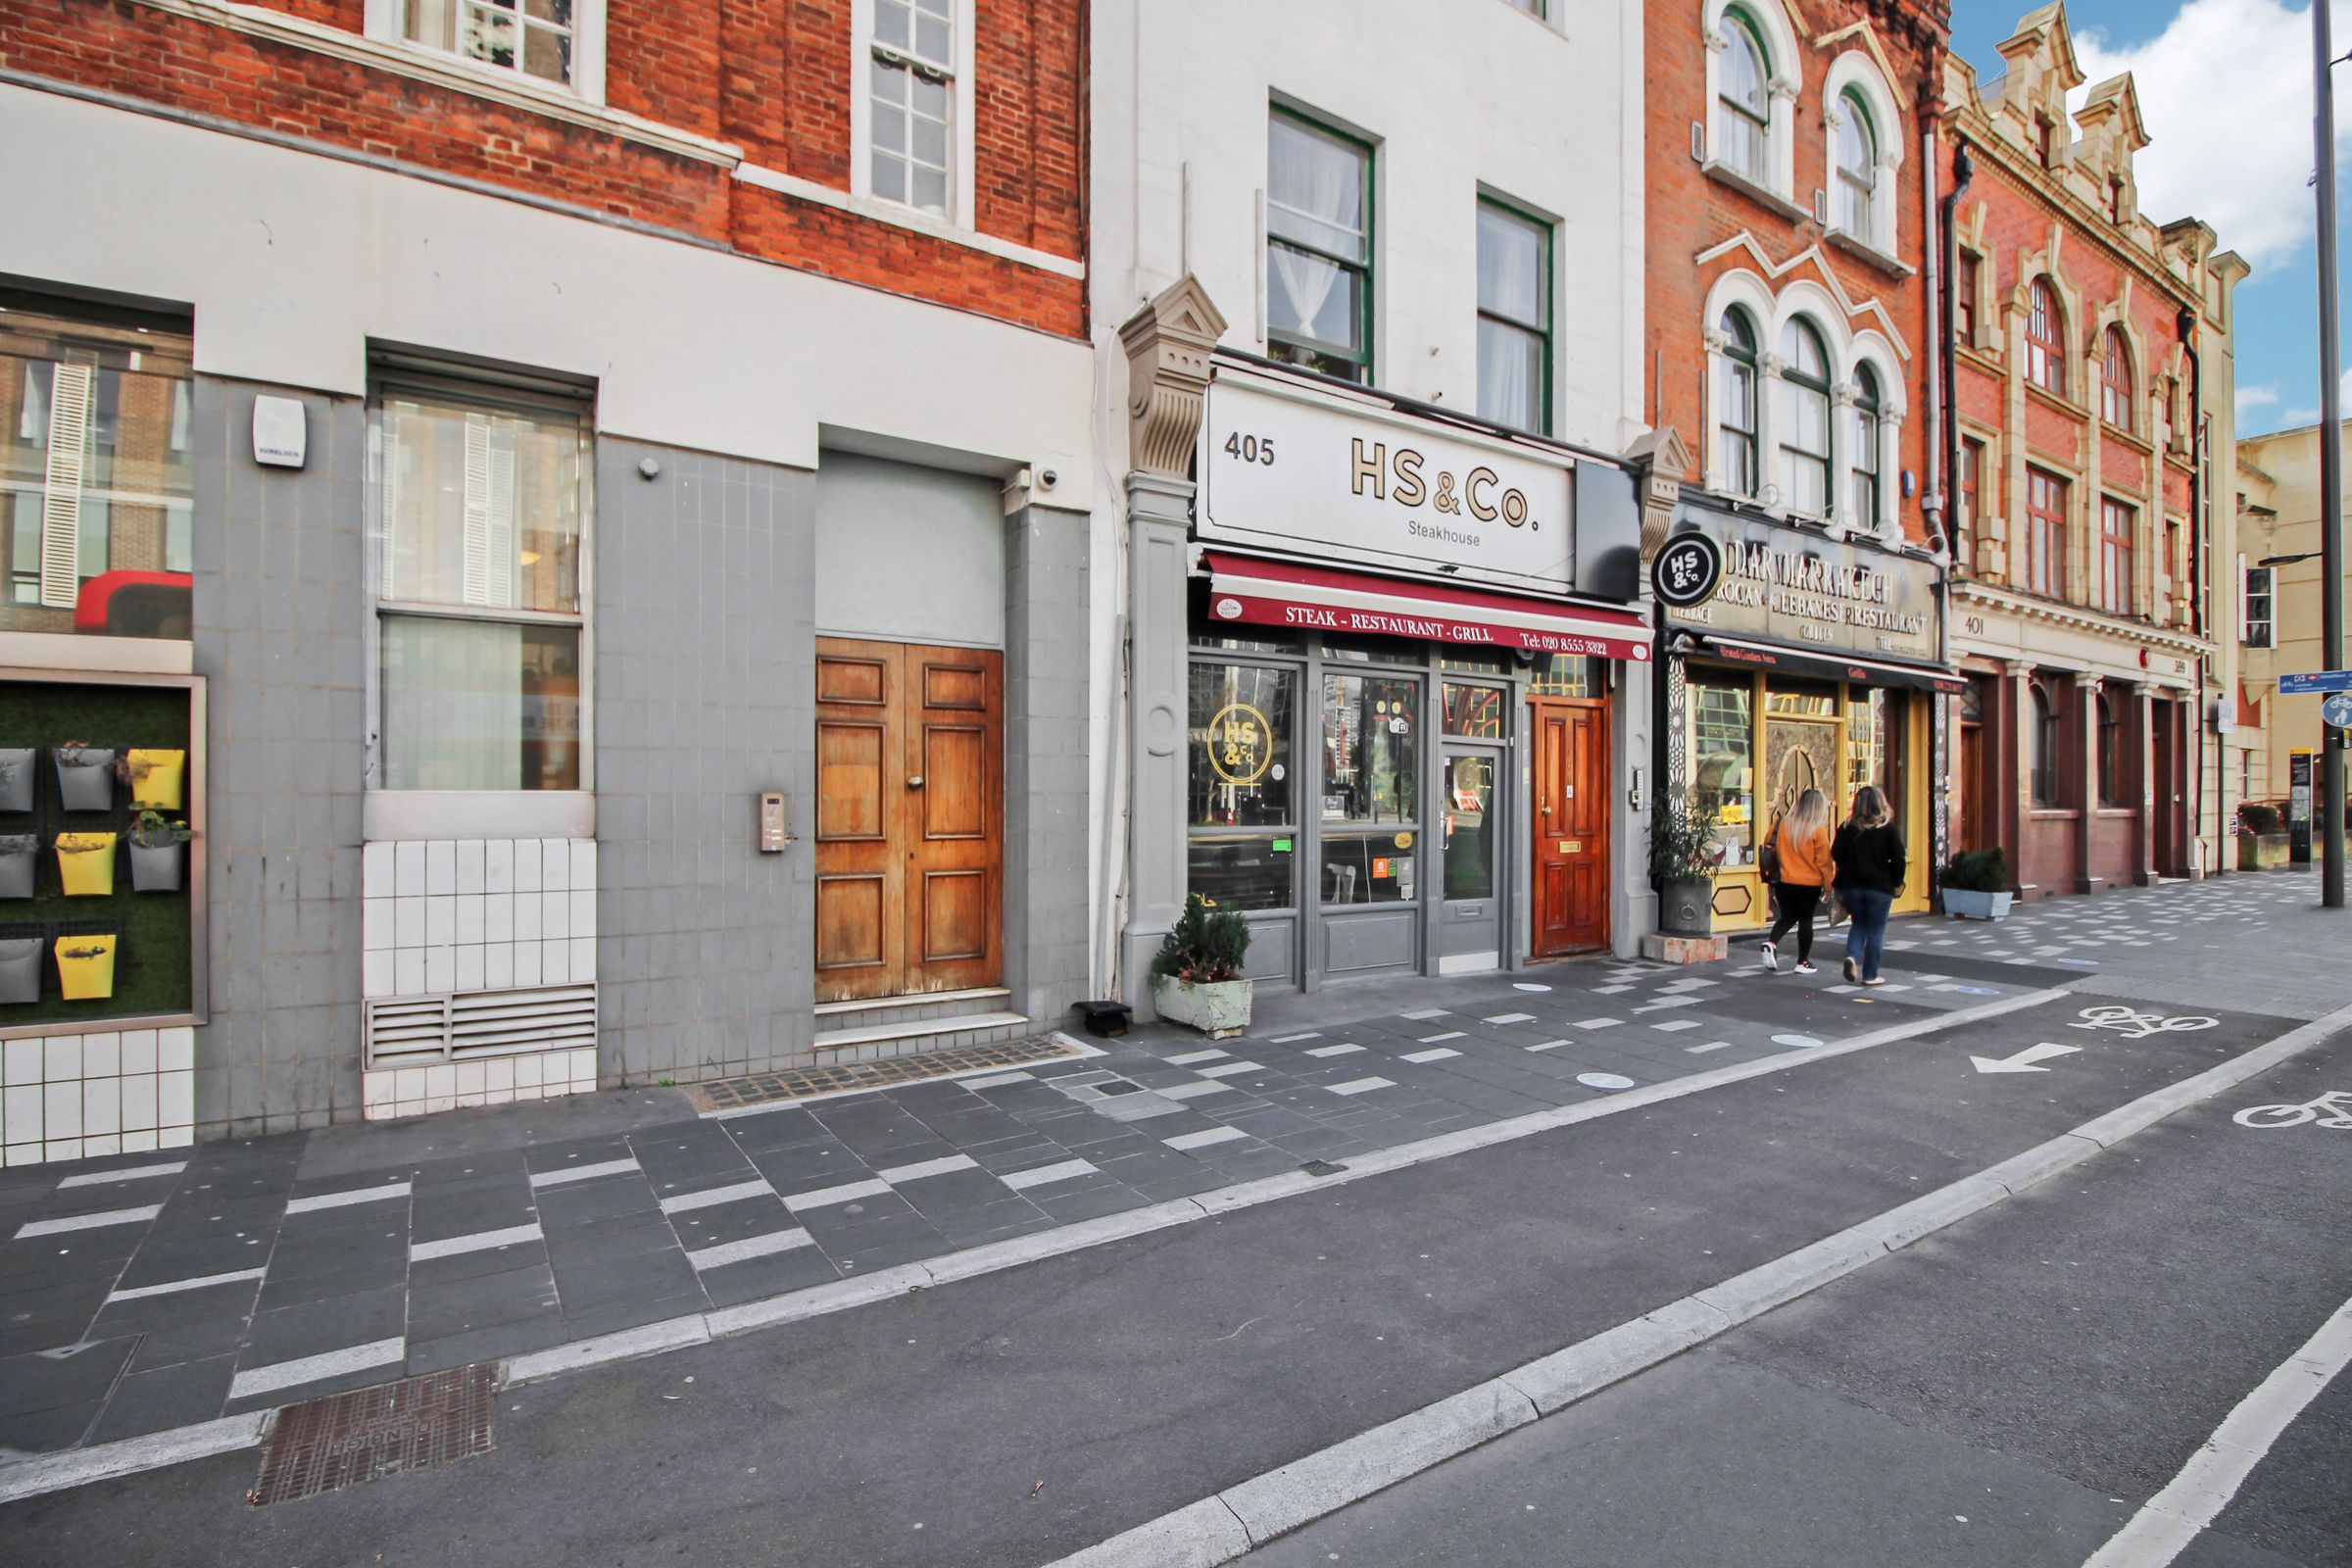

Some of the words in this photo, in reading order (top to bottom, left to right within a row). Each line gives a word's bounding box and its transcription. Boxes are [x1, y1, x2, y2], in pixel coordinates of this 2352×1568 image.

[1224, 431, 1274, 466] 405
[1408, 520, 1481, 547] Steakhouse
[1671, 551, 1698, 574] HS
[1727, 540, 1772, 582] DAR
[1775, 551, 1894, 605] MARRAKECH
[1773, 592, 1845, 623] LEBANESE
[1847, 605, 1928, 635] RESTAURANT
[1965, 615, 1984, 636] 401
[1286, 607, 1338, 627] STEAK
[1351, 613, 1444, 637] RESTAURANT
[1452, 625, 1494, 642] GRILL
[1520, 632, 1541, 649] Tel:
[1542, 636, 1558, 651] 020
[1560, 638, 1584, 653] 8555
[1585, 640, 1607, 656] 3322
[1225, 720, 1255, 744] HS
